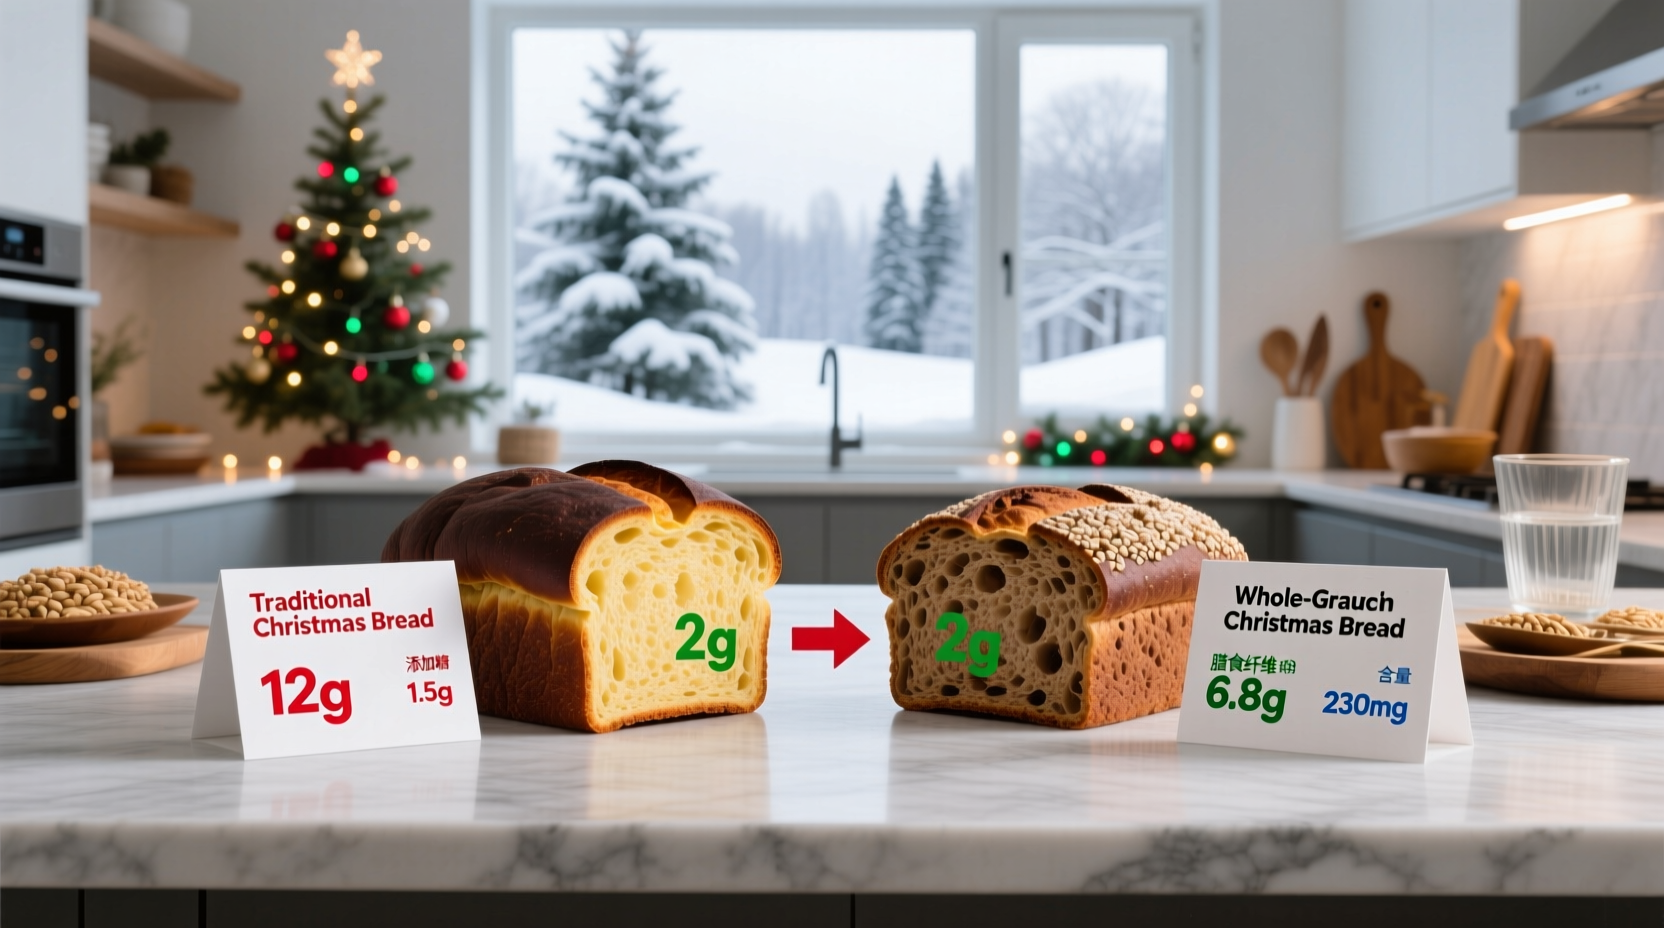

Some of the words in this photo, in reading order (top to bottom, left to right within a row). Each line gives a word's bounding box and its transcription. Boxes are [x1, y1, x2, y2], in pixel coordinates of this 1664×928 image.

[249, 587, 371, 613] Traditional
[1235, 585, 1394, 612] Whole-Grauch
[252, 615, 366, 638] Christmas
[372, 608, 434, 631] Bread
[1224, 611, 1333, 635] Christmas
[1338, 616, 1406, 639] Bread
[260, 666, 353, 725] 12g
[406, 681, 453, 707] 1.5g
[1206, 674, 1287, 724] 6.8g
[1322, 690, 1408, 725] 230mg
